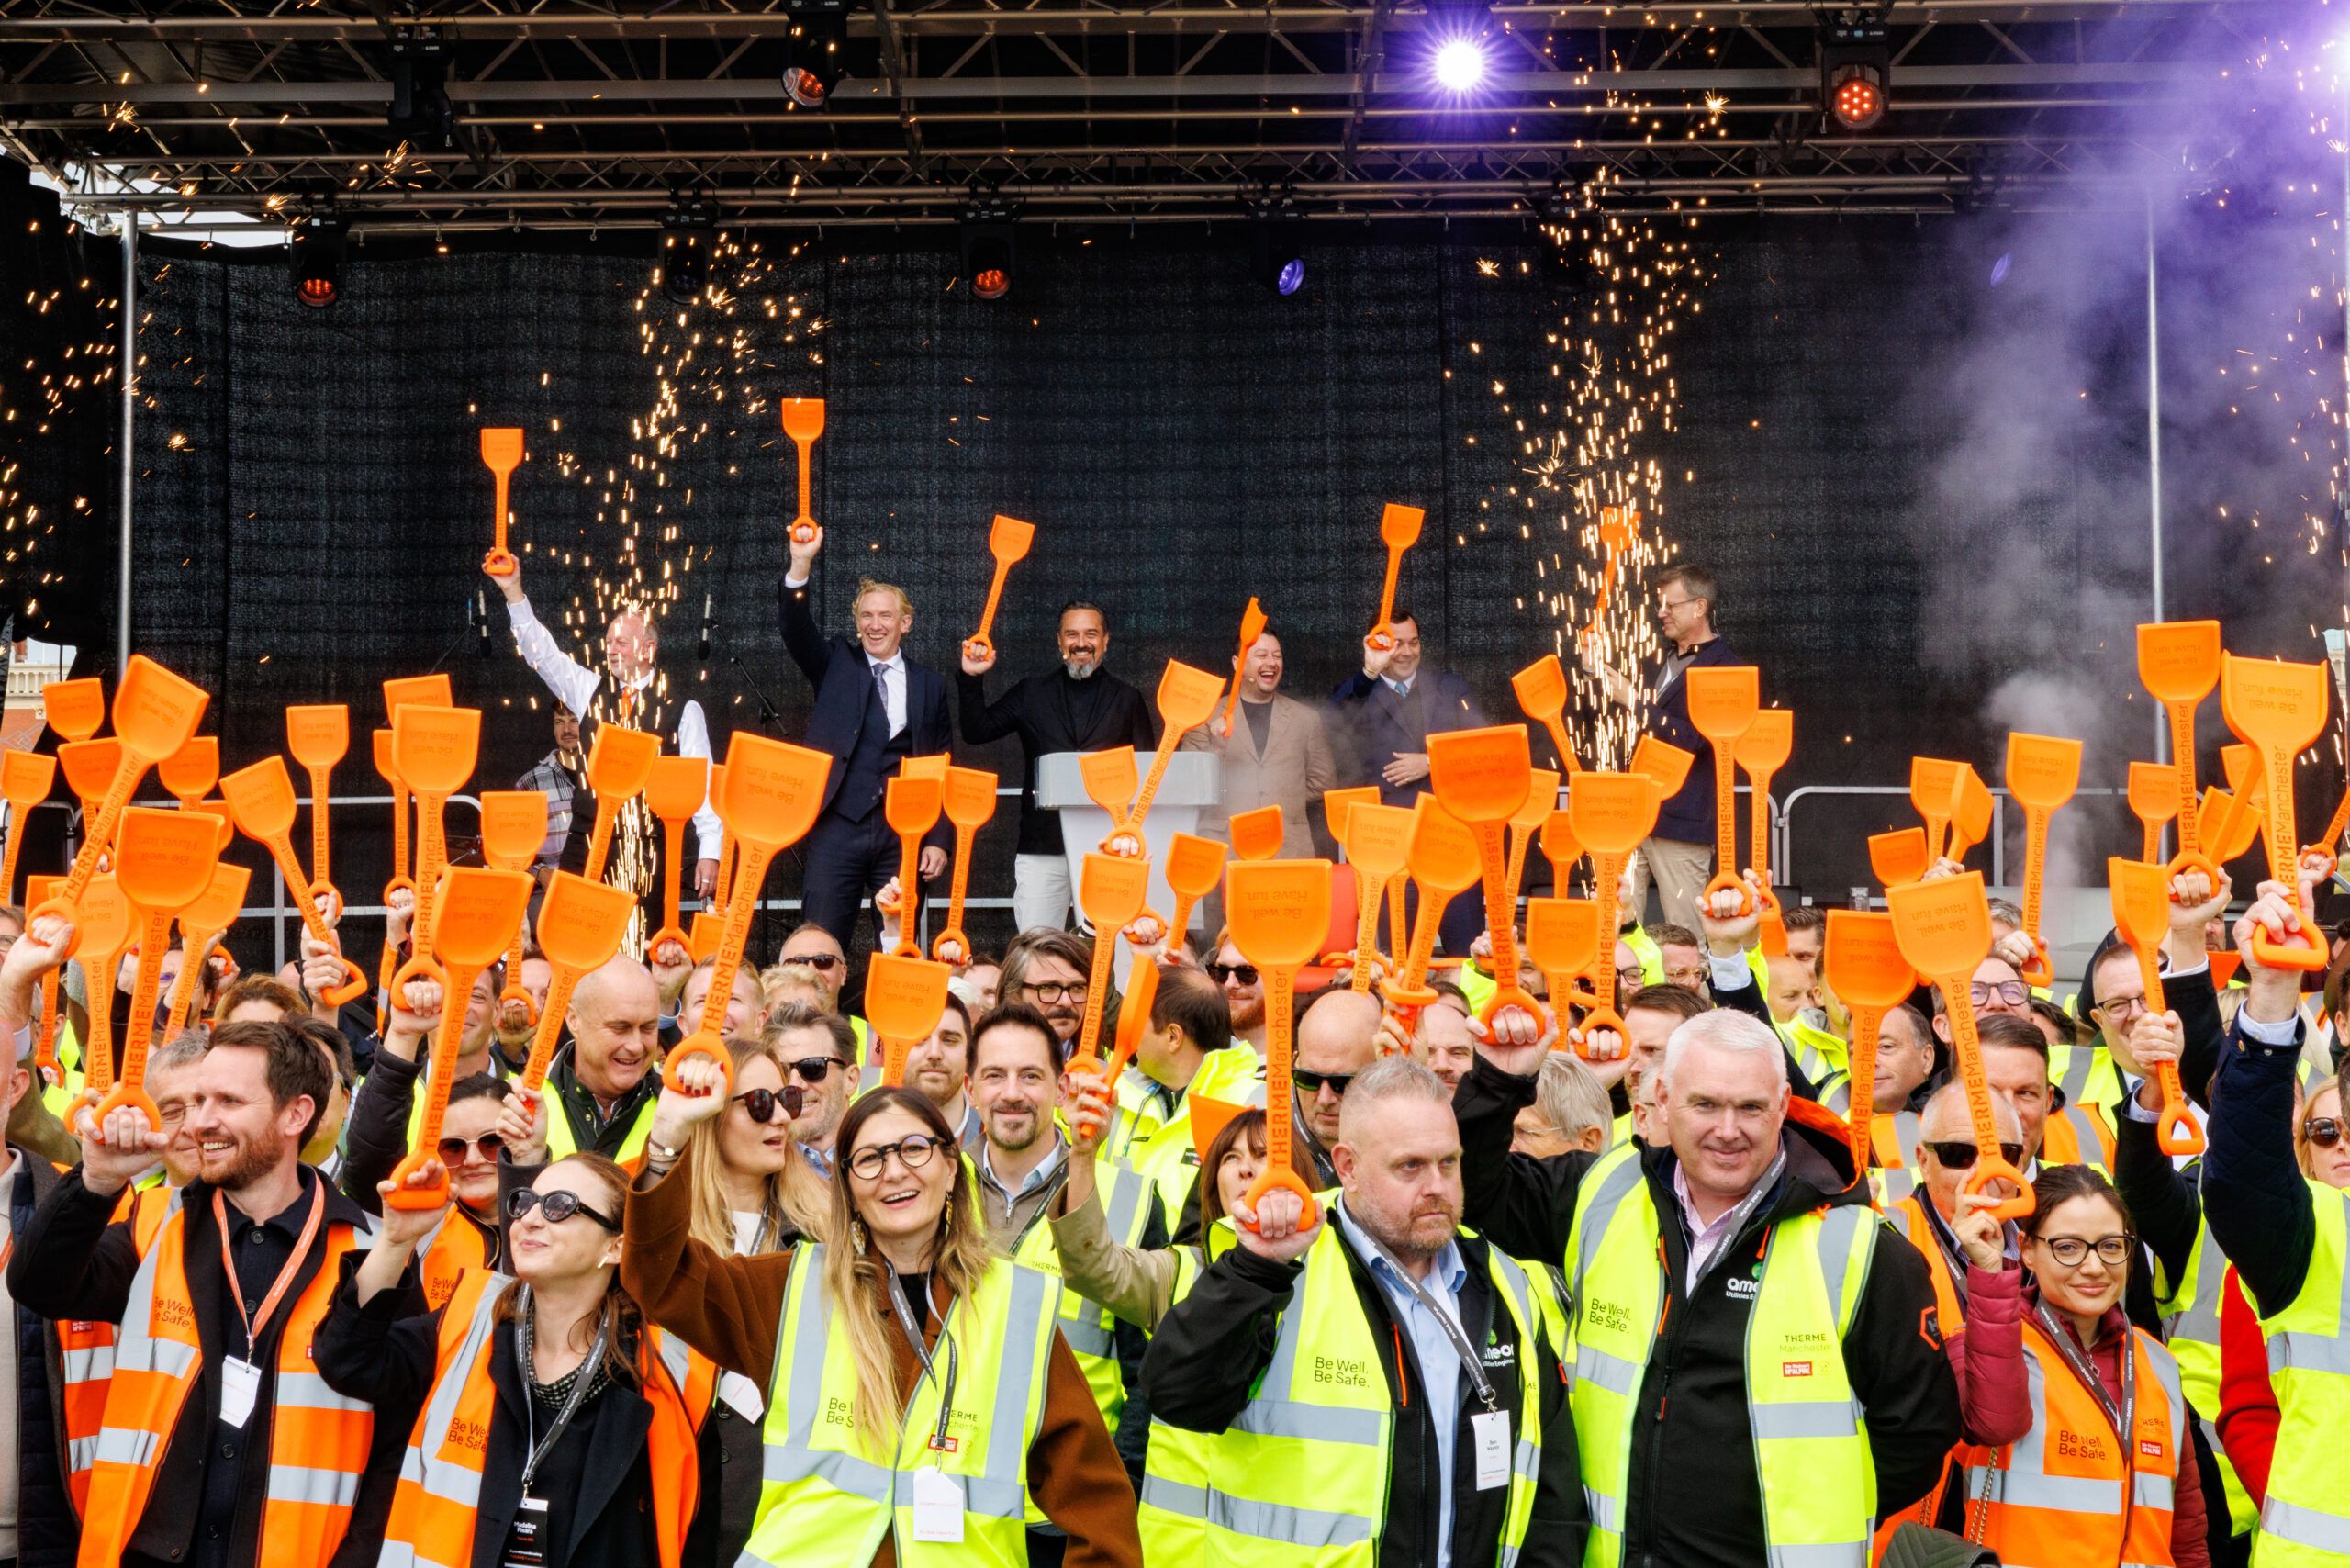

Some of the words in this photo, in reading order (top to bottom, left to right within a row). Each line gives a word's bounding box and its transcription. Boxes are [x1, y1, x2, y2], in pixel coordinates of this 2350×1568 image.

[2267, 686, 2302, 700] Have
[2279, 702, 2297, 714] Be
[778, 792, 794, 805] Be
[1272, 891, 1307, 902] Have
[1283, 908, 1302, 919] Be
[1935, 903, 1968, 917] Have
[1949, 920, 1966, 931] Be
[1591, 1298, 1606, 1313] Be
[1608, 1302, 1631, 1321] Well.
[1590, 1311, 1603, 1325] Be
[1605, 1316, 1629, 1334] Safe.
[1785, 1333, 1827, 1342] THERME
[1315, 1356, 1333, 1370] Be
[1337, 1359, 1368, 1373] Well.
[1315, 1370, 1333, 1383] Be
[1335, 1372, 1370, 1388] Safe.
[829, 1397, 846, 1412] Be
[452, 1417, 466, 1430] Be
[826, 1410, 844, 1424] Be
[448, 1430, 464, 1445] Be
[2060, 1430, 2078, 1443] Be
[2059, 1443, 2076, 1455] Be
